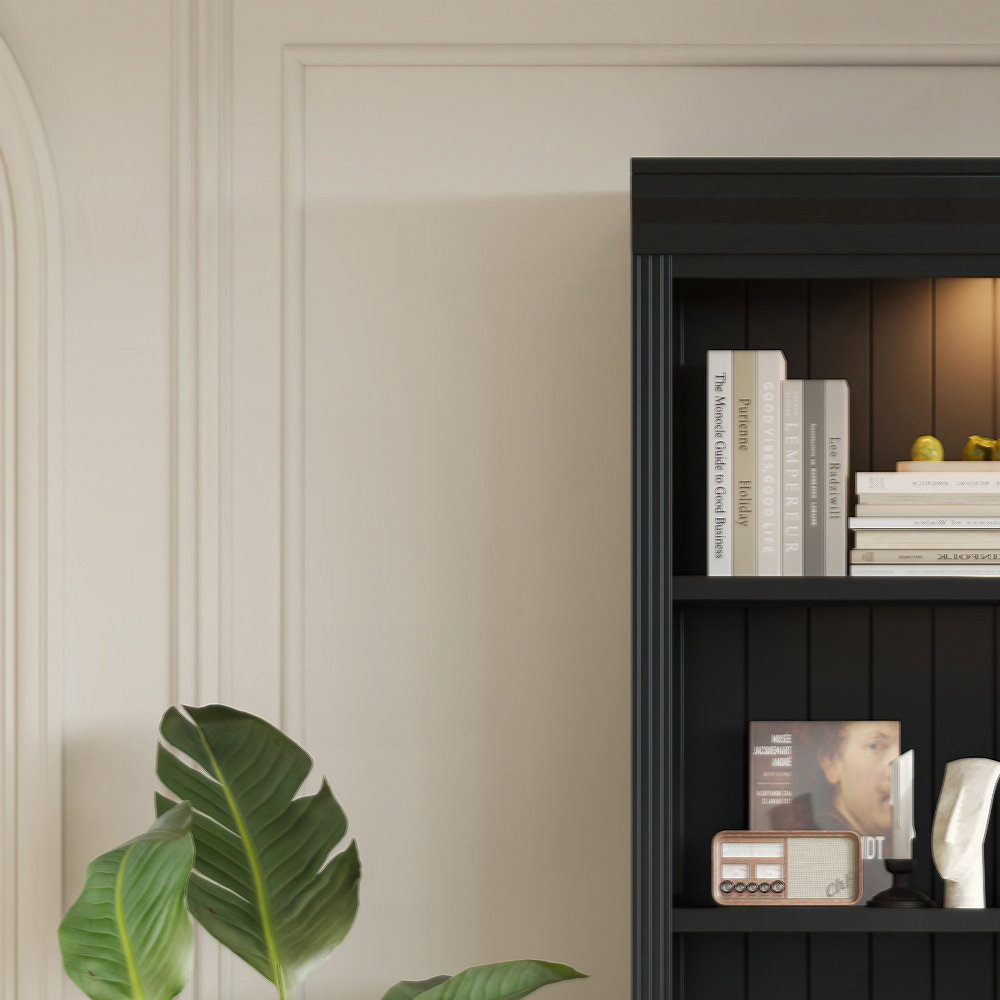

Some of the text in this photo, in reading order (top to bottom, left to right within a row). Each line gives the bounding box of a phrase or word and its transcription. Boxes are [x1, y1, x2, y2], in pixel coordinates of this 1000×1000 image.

[762, 382, 774, 424] GOOD
[714, 372, 726, 560] The Monocle Guide to Good Business
[735, 398, 751, 527] Purienne Holiday
[762, 475, 774, 517] GOOD
[784, 422, 800, 553] LEMPEREUR
[828, 436, 841, 519] Lee Radziwill
[762, 522, 774, 553] LIFE
